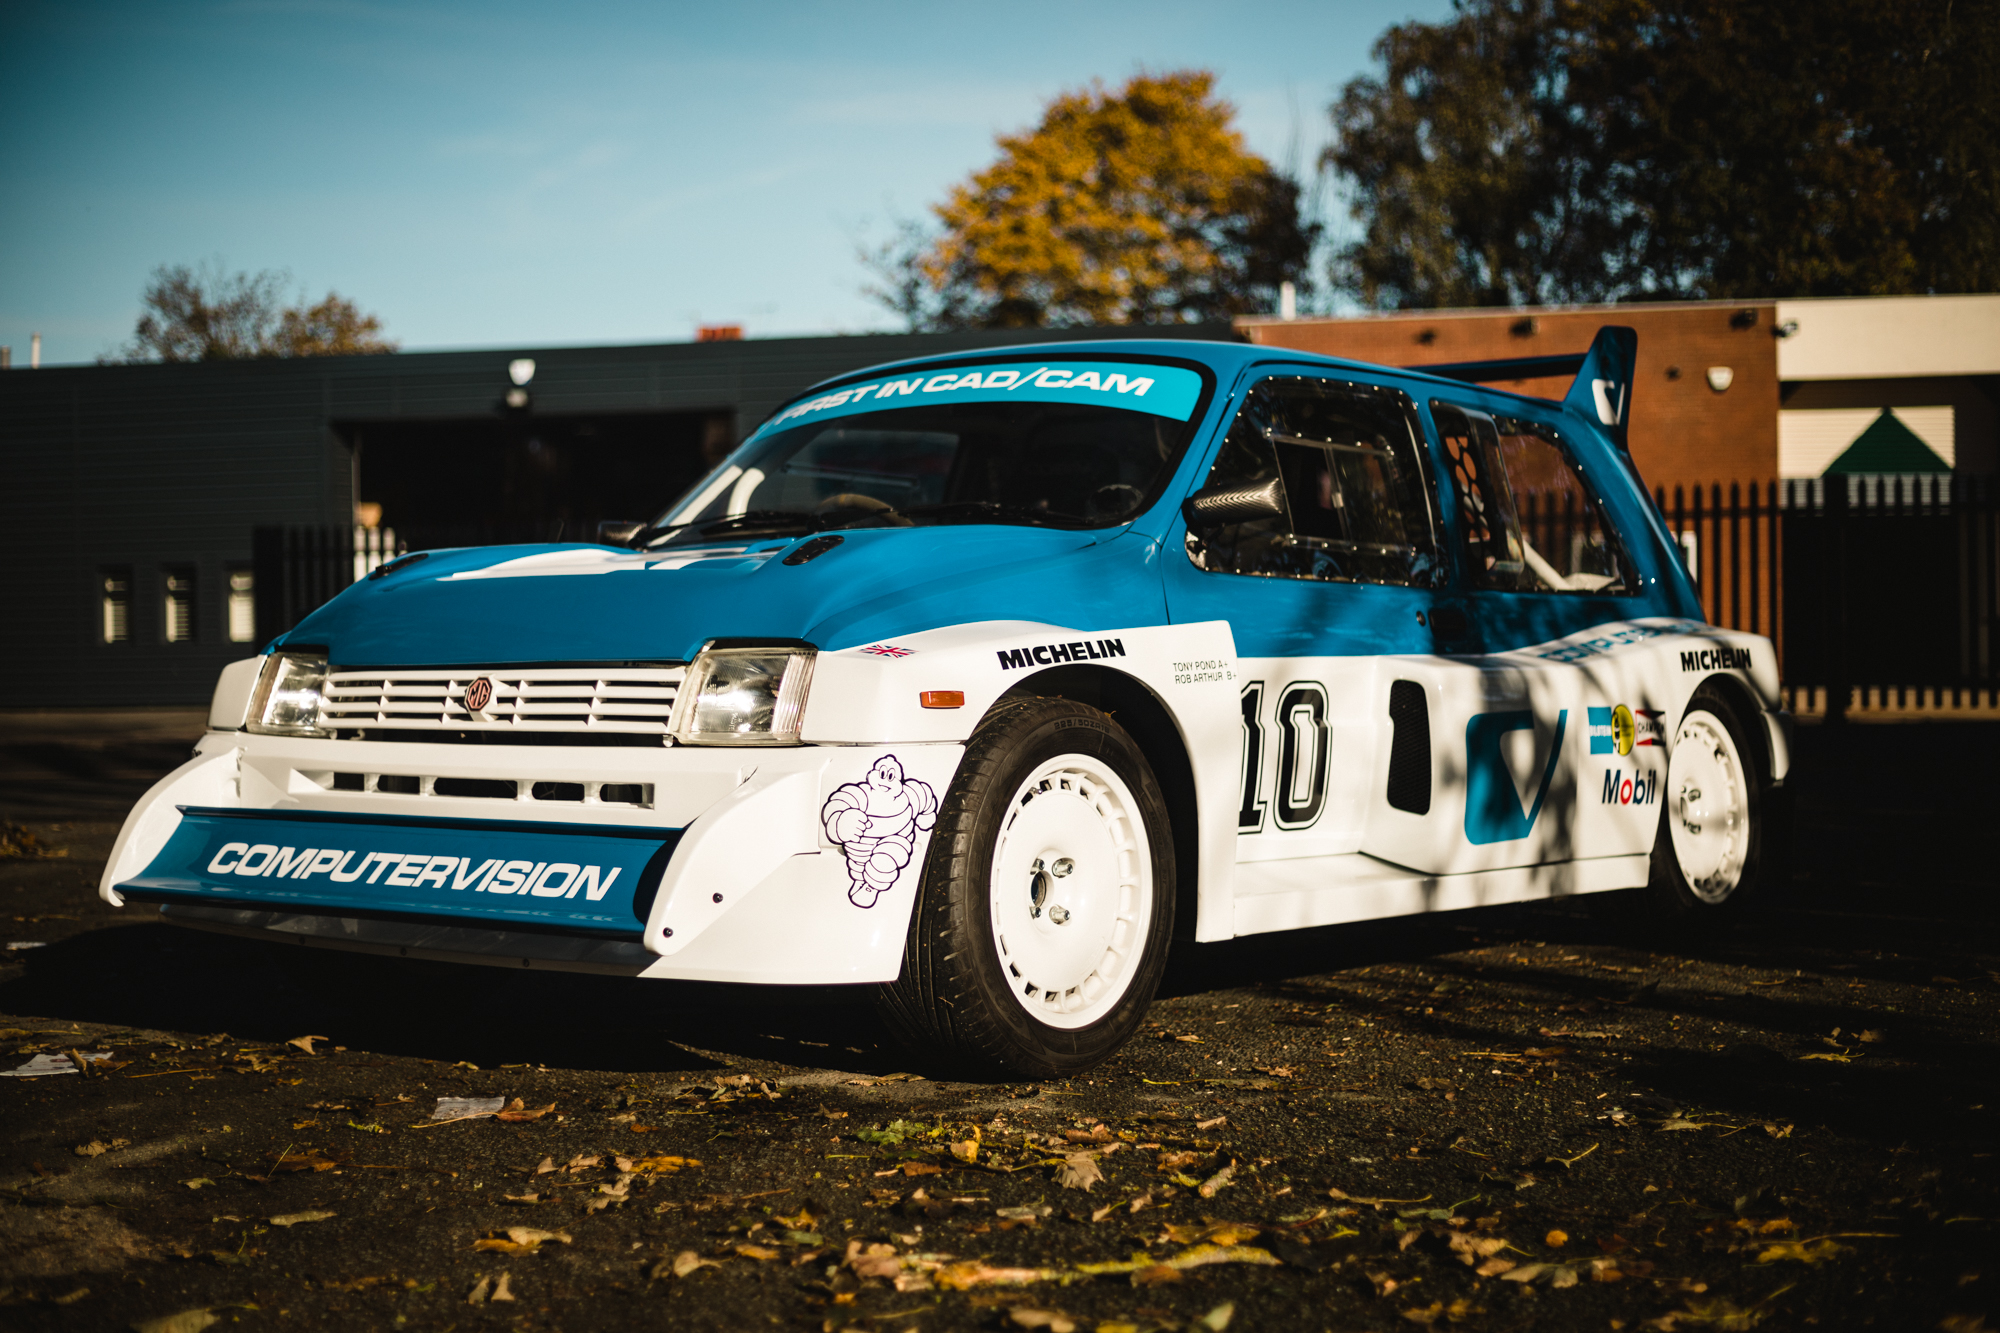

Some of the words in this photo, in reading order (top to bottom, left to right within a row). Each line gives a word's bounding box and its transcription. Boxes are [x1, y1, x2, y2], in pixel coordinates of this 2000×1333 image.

[874, 377, 925, 399] IN
[921, 366, 1156, 397] CAD/CAM
[996, 638, 1127, 671] MICHELIN
[1172, 662, 1193, 672] TONY
[1195, 660, 1217, 671] POND
[1680, 648, 1753, 673] MICHELIN
[1174, 673, 1192, 684] ROB
[1194, 671, 1224, 683] ARTHUR
[1237, 680, 1334, 836] 10
[1601, 768, 1657, 805] Mobil
[207, 841, 623, 902] COMPUTERVISION
